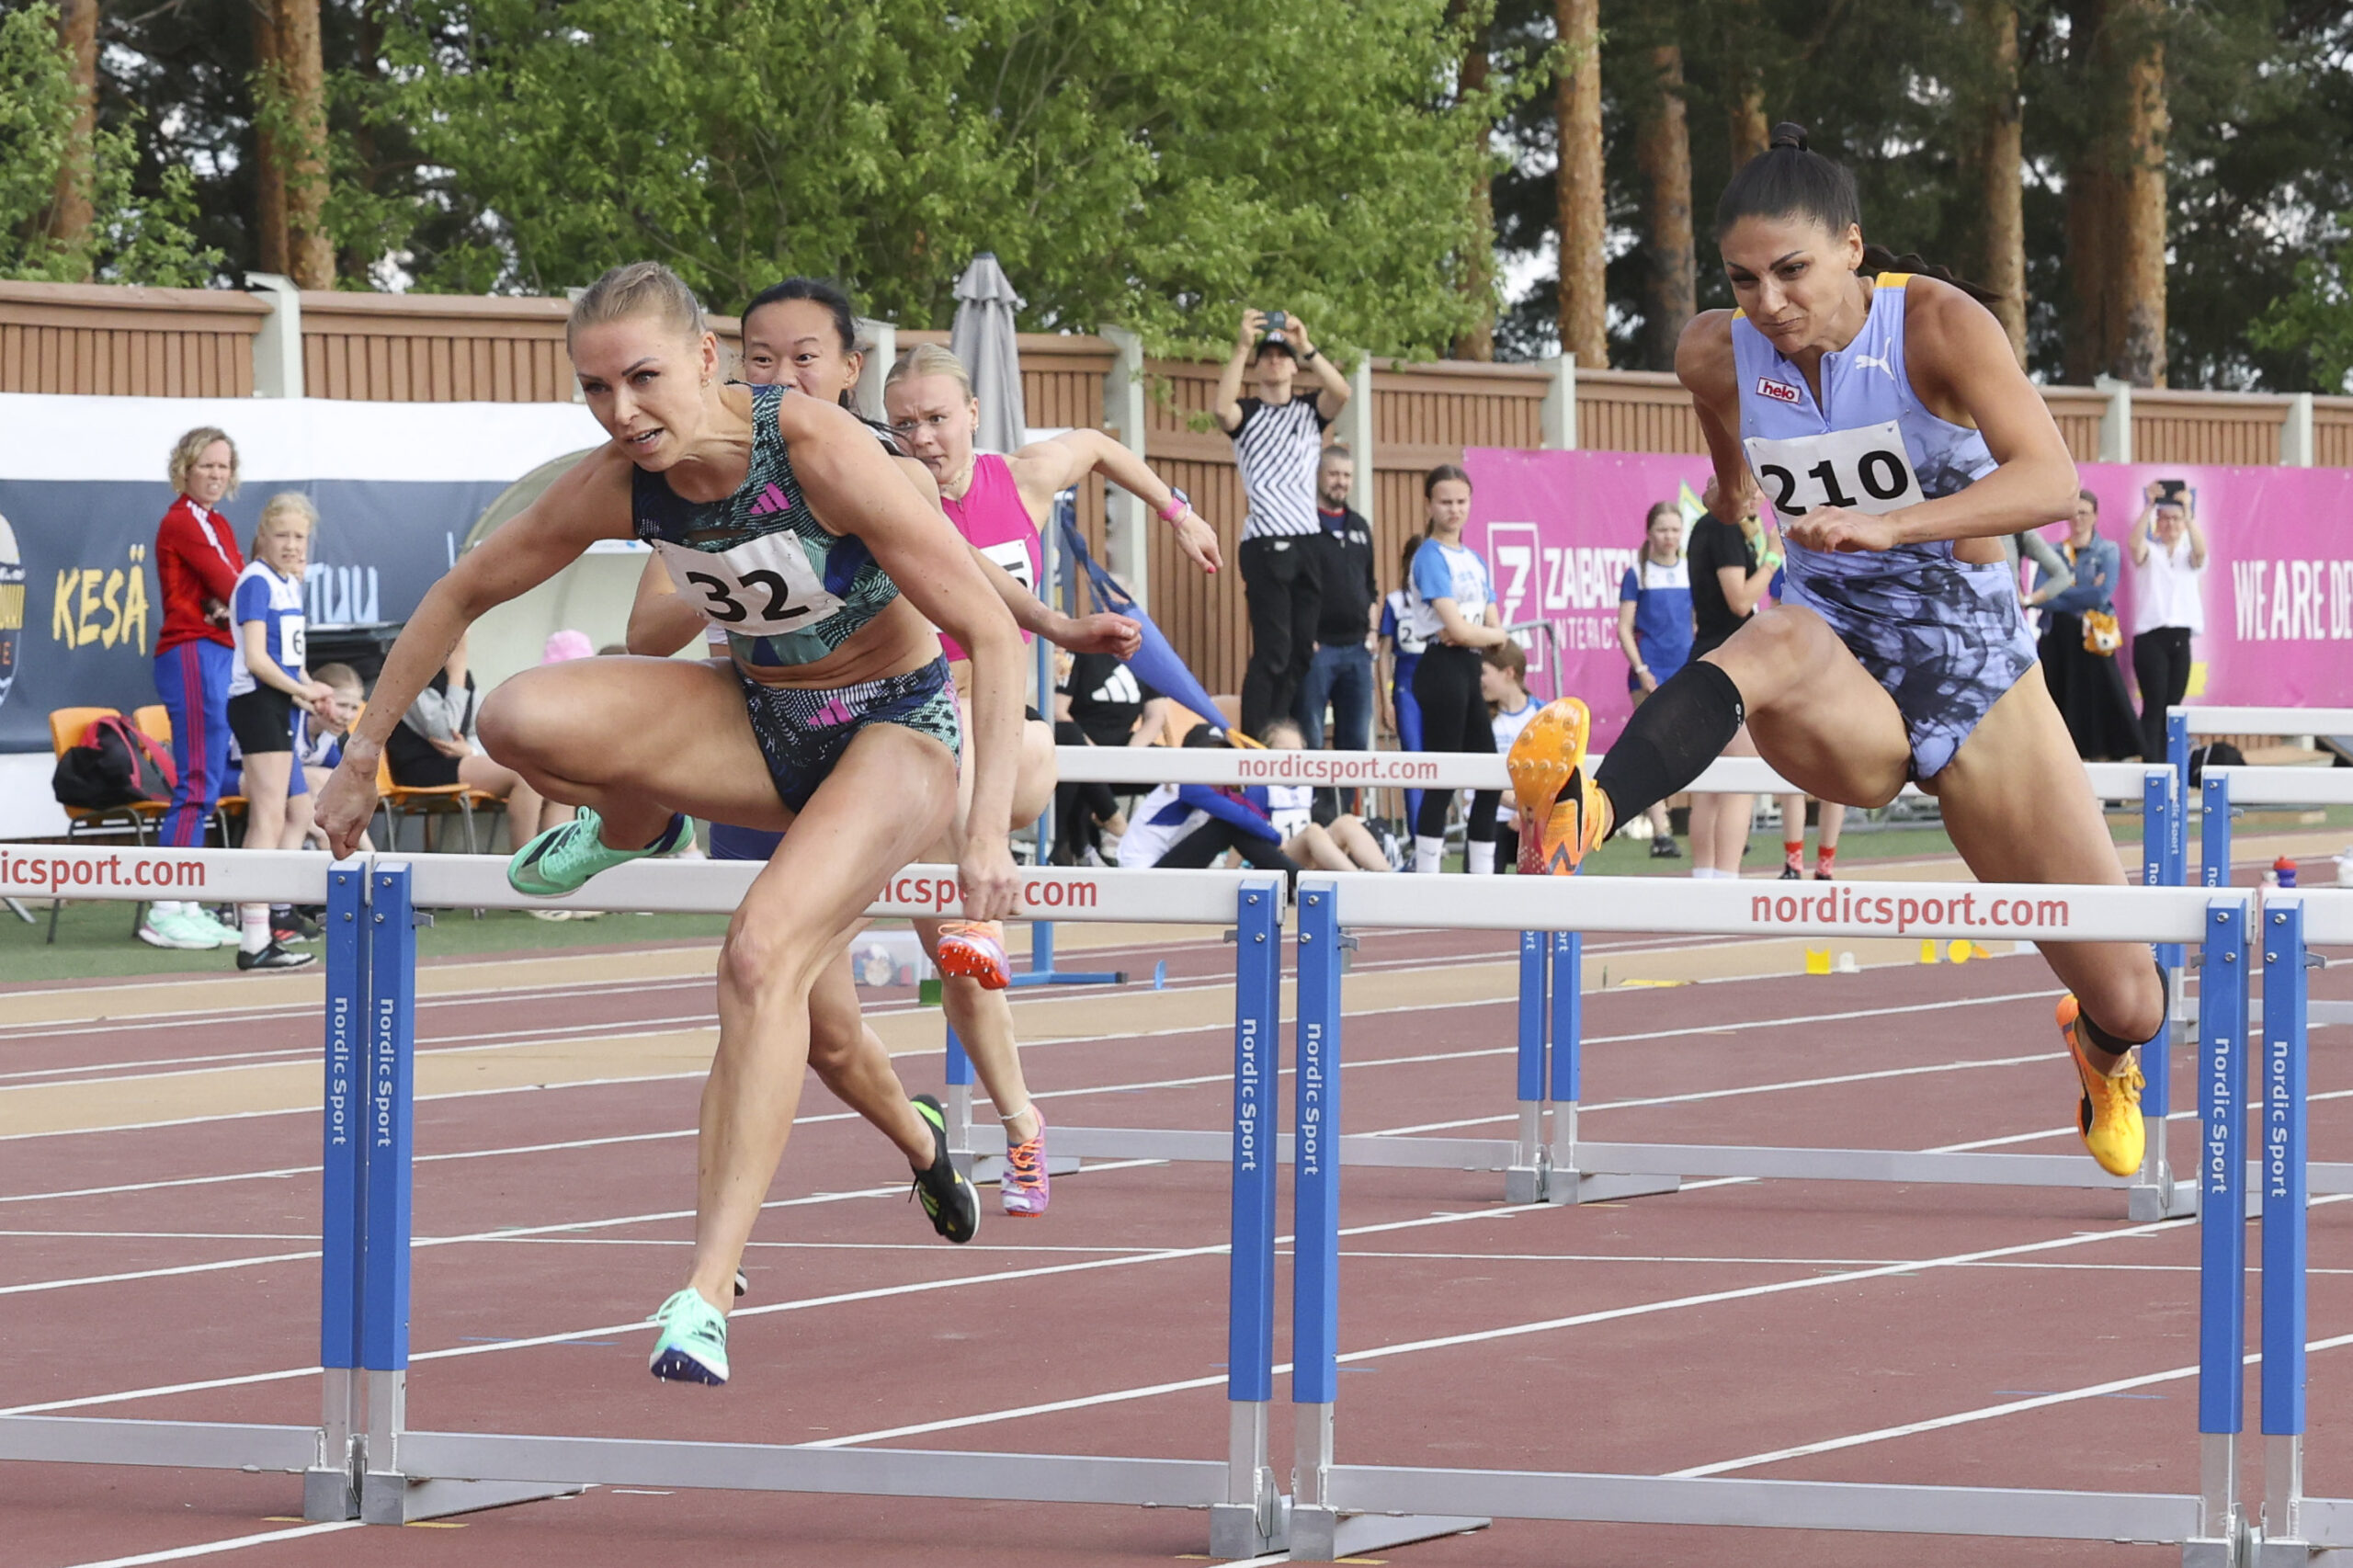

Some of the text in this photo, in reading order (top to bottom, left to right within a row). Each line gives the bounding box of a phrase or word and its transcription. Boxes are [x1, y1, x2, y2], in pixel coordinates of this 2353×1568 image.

[1763, 381, 1795, 400] helo
[1759, 449, 1909, 517] 210
[52, 543, 150, 657] KESÄ
[304, 562, 380, 625] TUU
[686, 569, 812, 623] 32
[1543, 547, 1635, 609] ZABATS
[2232, 559, 2353, 641] WE ARE DE
[1237, 754, 1438, 783] nordicsport.com
[0, 850, 206, 893] icsport.com
[1751, 887, 2069, 934] nordicsport.com
[330, 997, 349, 1145] nordic Sport
[375, 998, 395, 1148] nordic Sport
[1238, 1018, 1258, 1171] nordic Sport
[1302, 1023, 1323, 1176] nordic Sport
[2209, 1038, 2231, 1194] nordic Sport
[2268, 1040, 2290, 1197] nordic Sport
